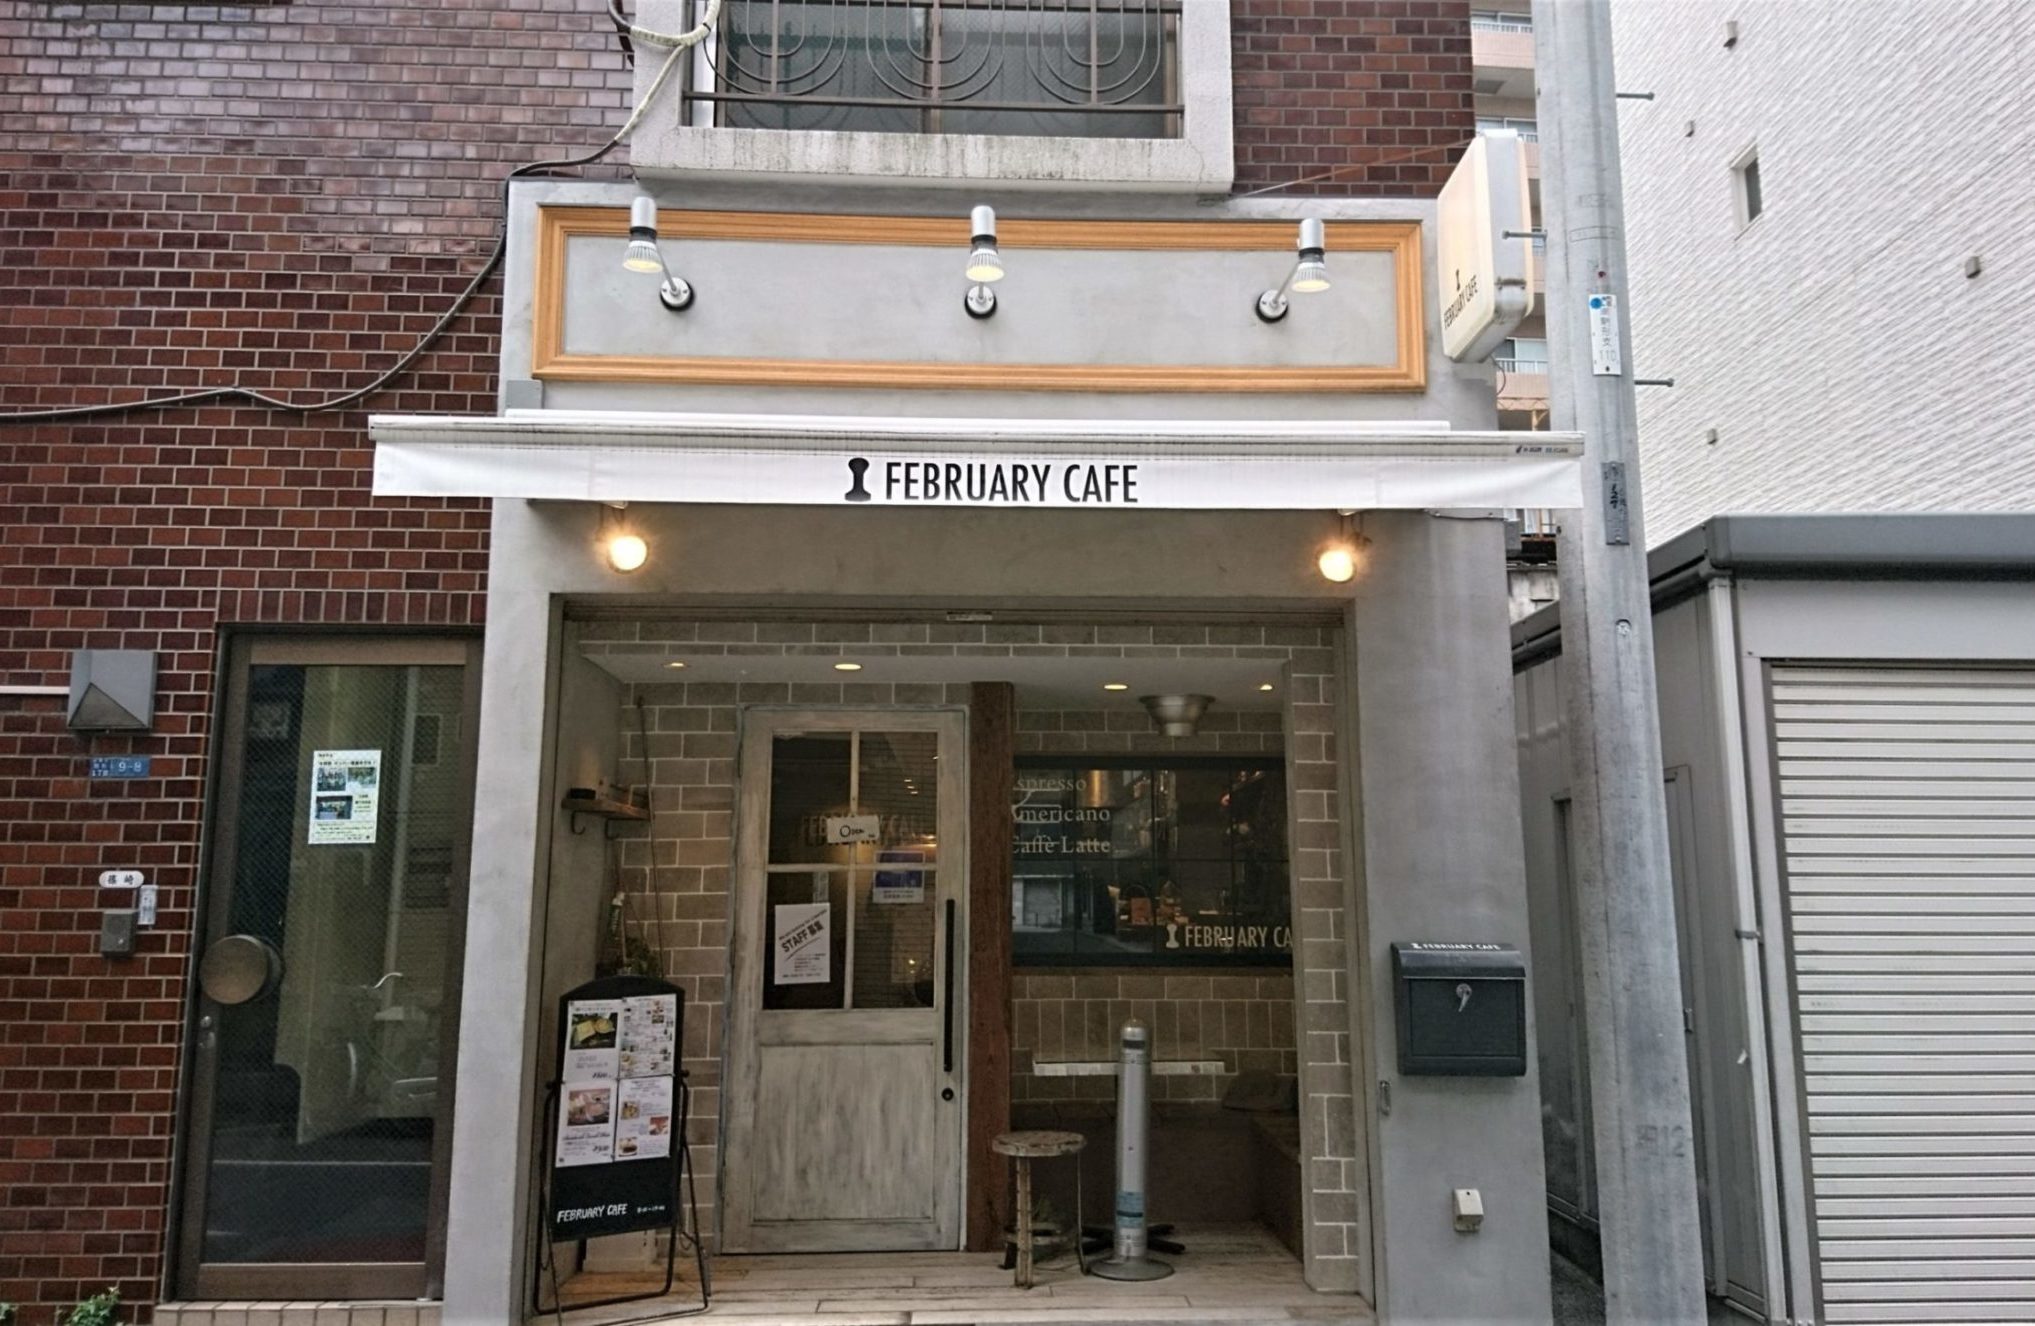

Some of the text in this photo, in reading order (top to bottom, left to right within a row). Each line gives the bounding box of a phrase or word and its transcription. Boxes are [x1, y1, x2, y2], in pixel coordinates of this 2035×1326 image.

[1444, 274, 1479, 331] FEBRUARY CAFE
[885, 461, 1139, 503] FEBRUARY CAFE
[1014, 778, 1088, 792] spresso
[1013, 808, 1111, 823] mericano
[1060, 835, 1111, 855] Latte
[781, 928, 809, 953] STAFF
[1184, 925, 1268, 948] FEBRUARY
[556, 1204, 606, 1224] FEBRUARY
[606, 1202, 629, 1217] CAFE
